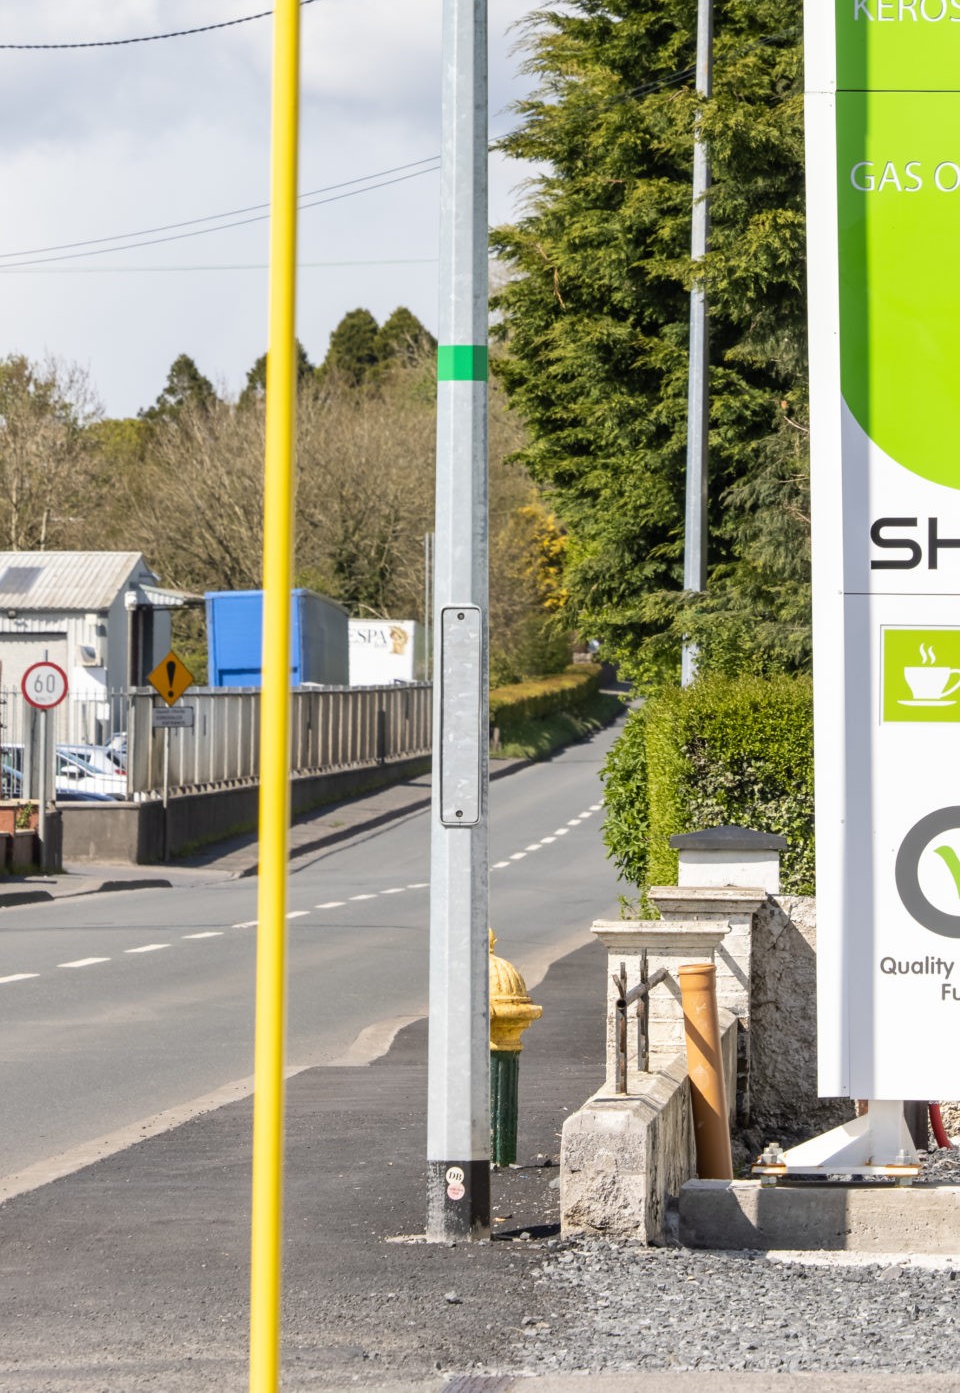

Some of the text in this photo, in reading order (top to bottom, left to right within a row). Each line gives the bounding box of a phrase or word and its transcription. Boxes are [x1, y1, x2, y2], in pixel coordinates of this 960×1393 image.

[850, 161, 923, 192] GAS
[33, 674, 55, 693] 60
[879, 955, 954, 979] Quality
